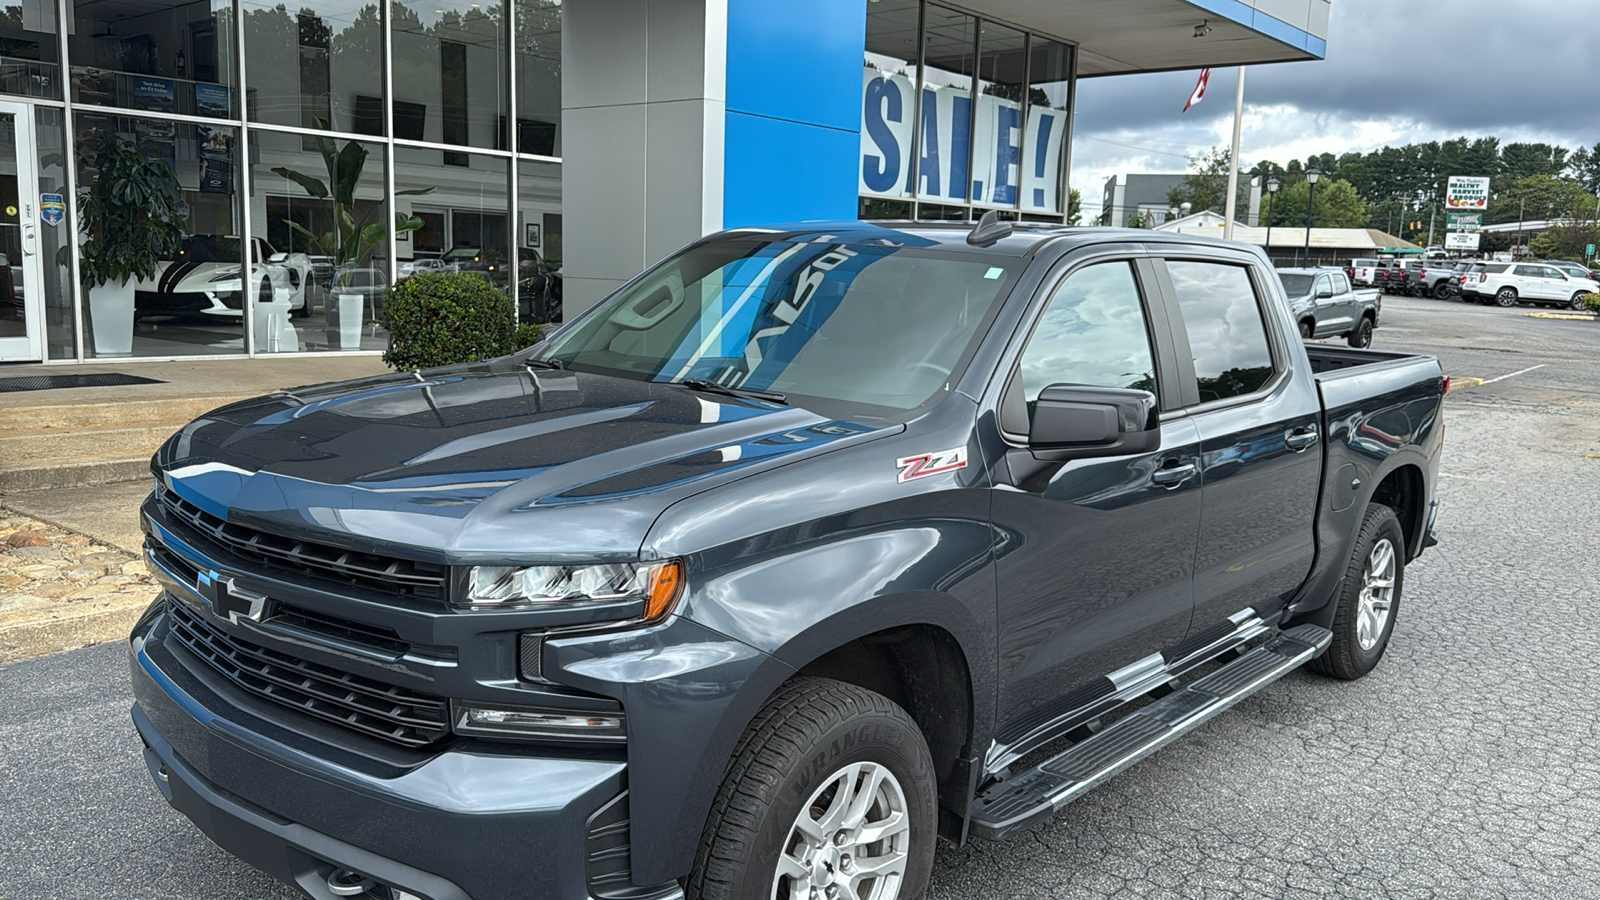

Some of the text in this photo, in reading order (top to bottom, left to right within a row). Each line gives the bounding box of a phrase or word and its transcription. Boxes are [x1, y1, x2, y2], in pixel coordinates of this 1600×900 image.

[863, 76, 1055, 207] SALE!
[896, 445, 968, 484] Z71
[791, 722, 906, 797] WRANGLER
